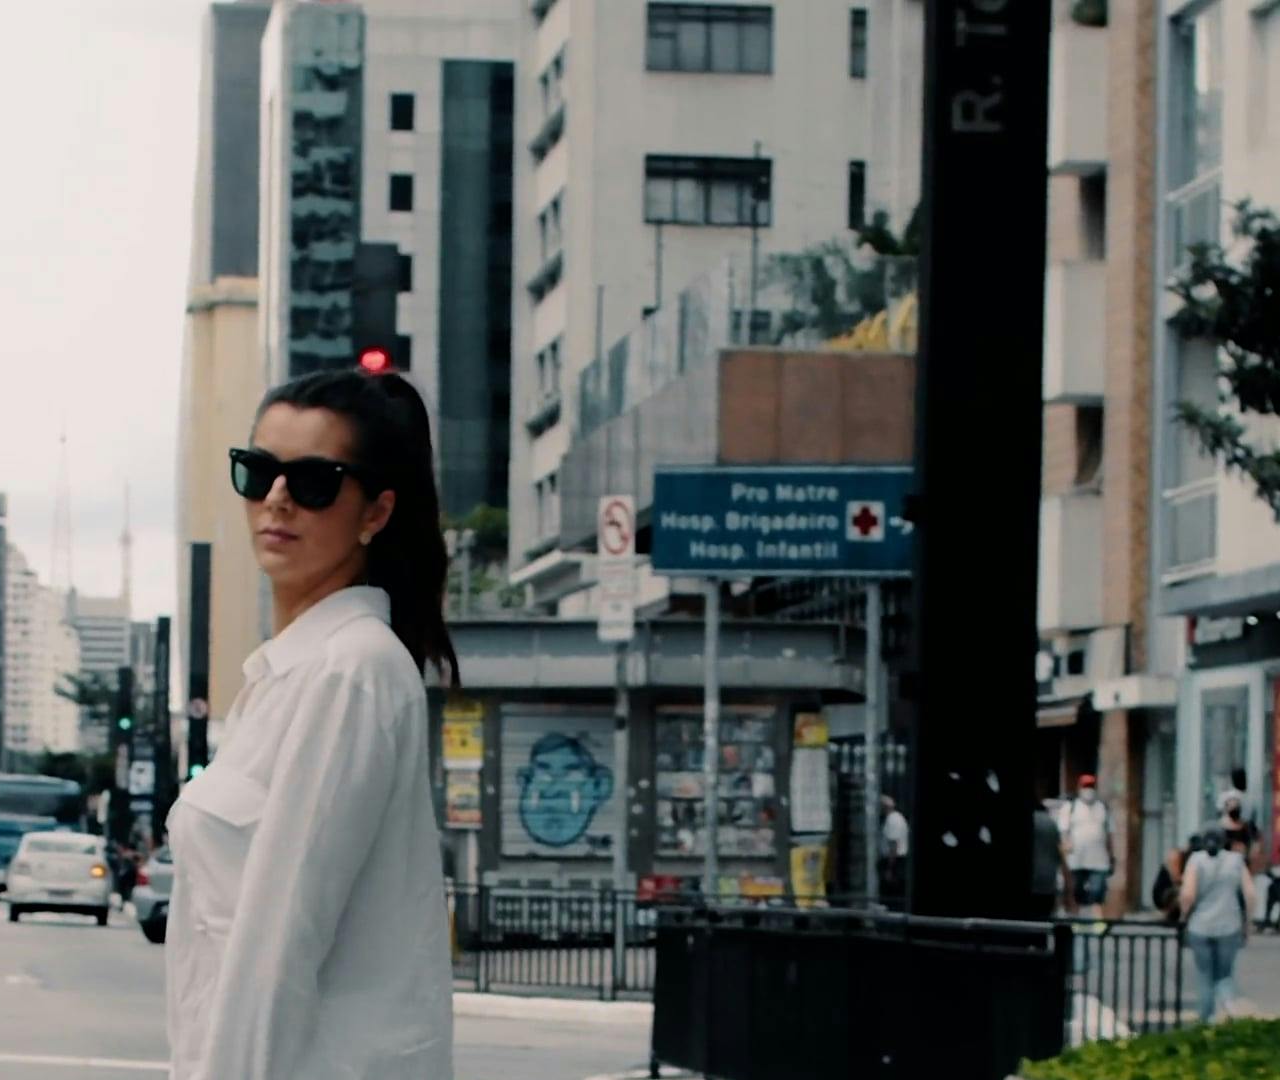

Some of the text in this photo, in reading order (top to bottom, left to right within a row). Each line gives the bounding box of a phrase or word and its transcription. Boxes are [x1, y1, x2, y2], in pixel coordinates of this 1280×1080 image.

[951, 74, 1007, 133] R.
[731, 482, 770, 503] Pro
[660, 510, 840, 535] Hosp. Brigadeiro
[690, 540, 840, 562] Hosp. Infantil
